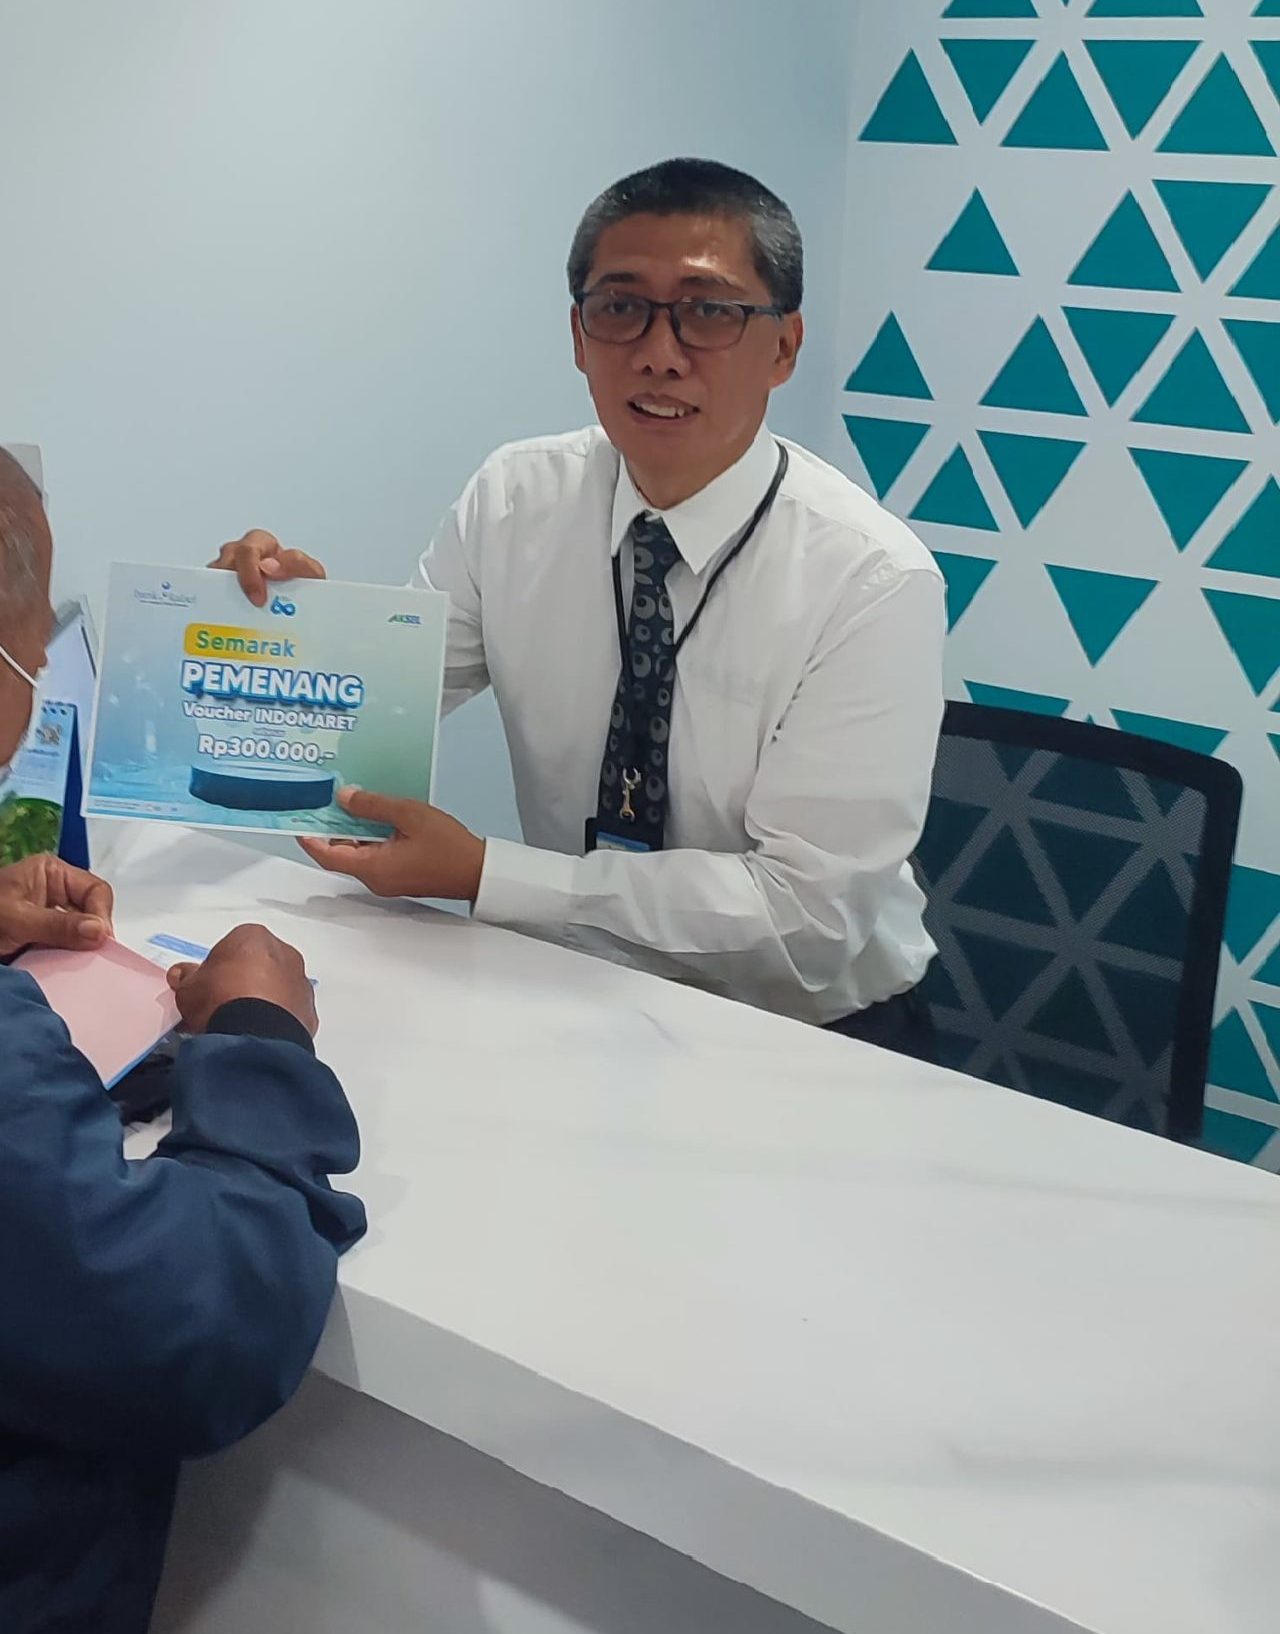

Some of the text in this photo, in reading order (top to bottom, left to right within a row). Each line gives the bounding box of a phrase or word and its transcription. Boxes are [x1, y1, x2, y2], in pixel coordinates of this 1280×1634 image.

[195, 630, 297, 658] Semarak
[182, 661, 363, 706] PEMENANG
[183, 702, 357, 730] Voucher INDOMARET
